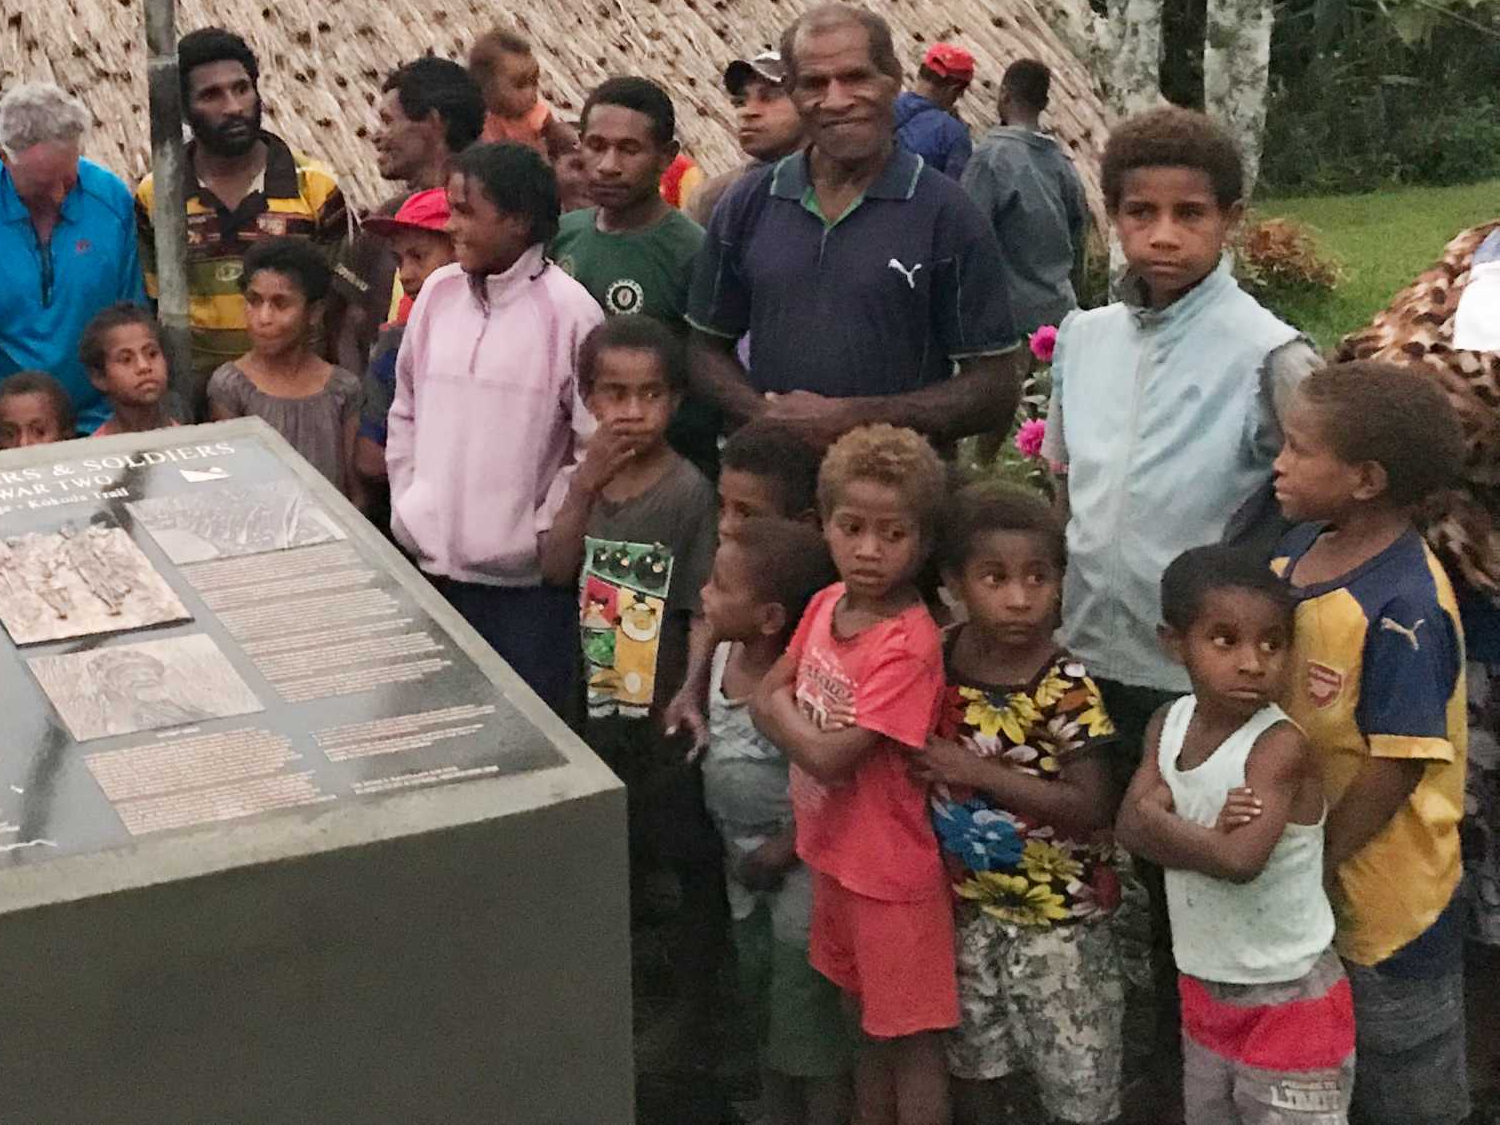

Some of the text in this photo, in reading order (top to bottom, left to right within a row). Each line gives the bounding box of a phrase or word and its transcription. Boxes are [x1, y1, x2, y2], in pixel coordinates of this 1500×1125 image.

[52, 463, 75, 476] &
[83, 442, 235, 472] SOLDIERS
[52, 474, 112, 491] TWO
[28, 495, 88, 510] Kokoda
[91, 487, 129, 500] Trail
